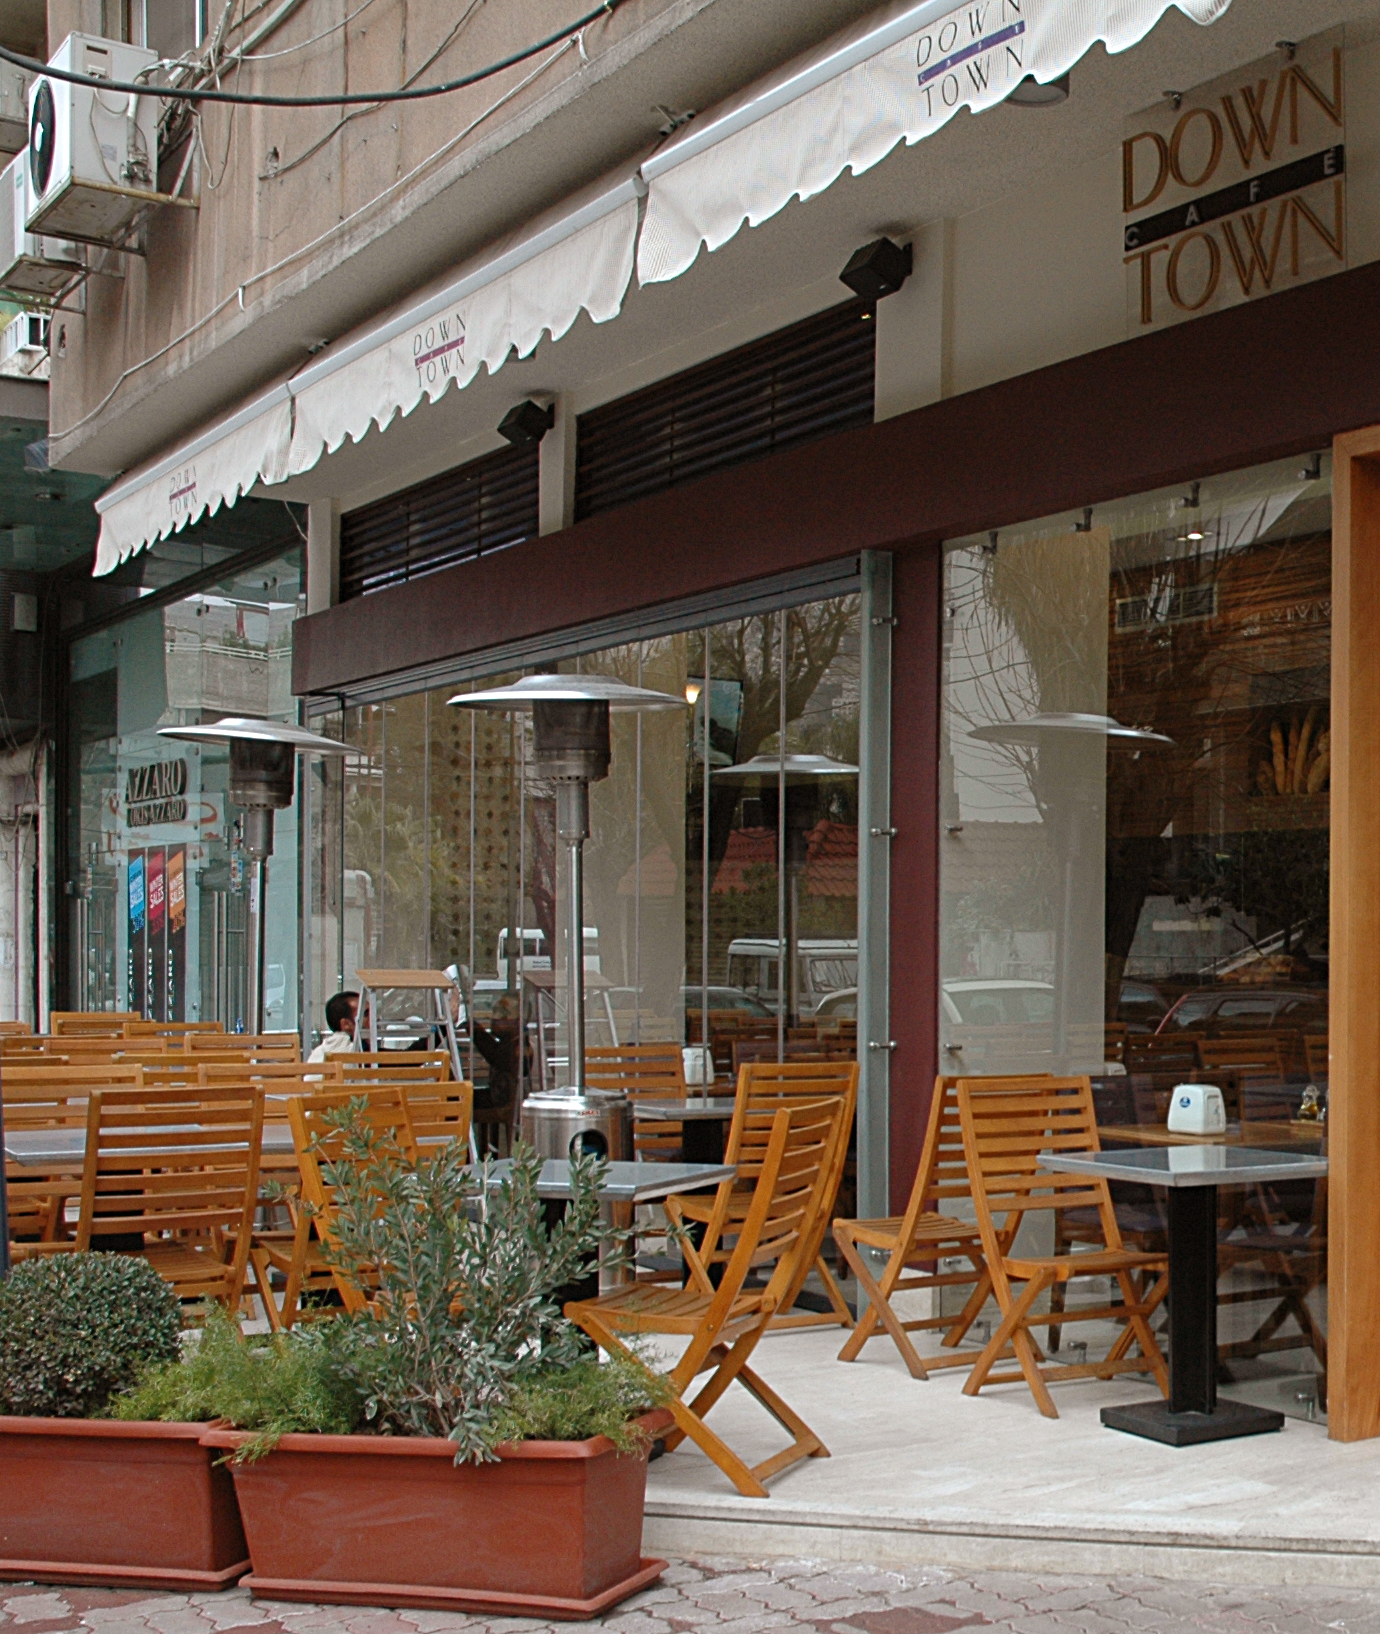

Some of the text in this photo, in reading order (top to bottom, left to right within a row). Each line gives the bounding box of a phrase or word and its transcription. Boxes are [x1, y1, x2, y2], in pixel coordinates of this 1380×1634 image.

[917, 0, 1021, 67] DOWN
[922, 38, 1024, 117] TOWN
[1122, 47, 1343, 213] DOWN
[1122, 179, 1344, 325] TOWN
[413, 309, 466, 356] DOWN
[416, 345, 466, 388] TOWN
[125, 758, 187, 804] AZZARO
